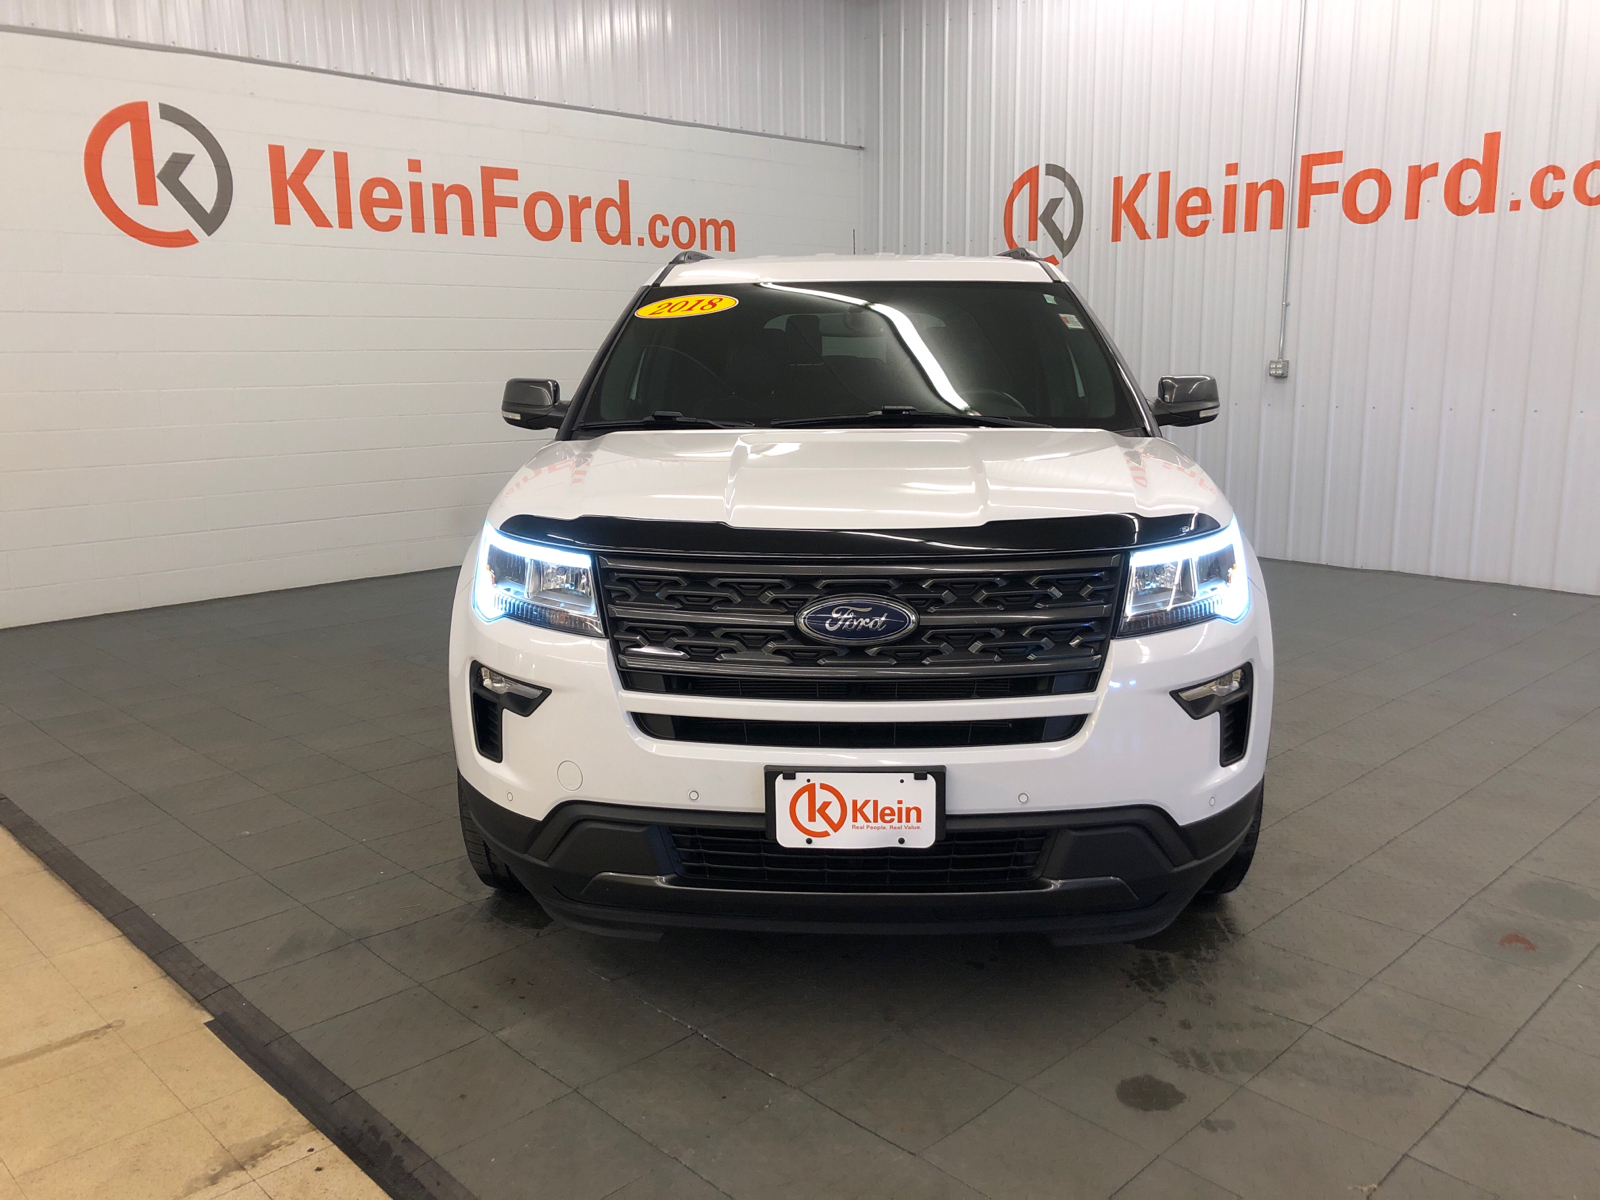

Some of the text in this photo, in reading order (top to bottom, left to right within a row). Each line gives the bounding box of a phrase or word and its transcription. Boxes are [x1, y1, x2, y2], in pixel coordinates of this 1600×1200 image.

[268, 144, 736, 253] KleinFord.com
[648, 297, 723, 316] 2018
[825, 606, 888, 632] Ford
[852, 799, 922, 824] Klein
